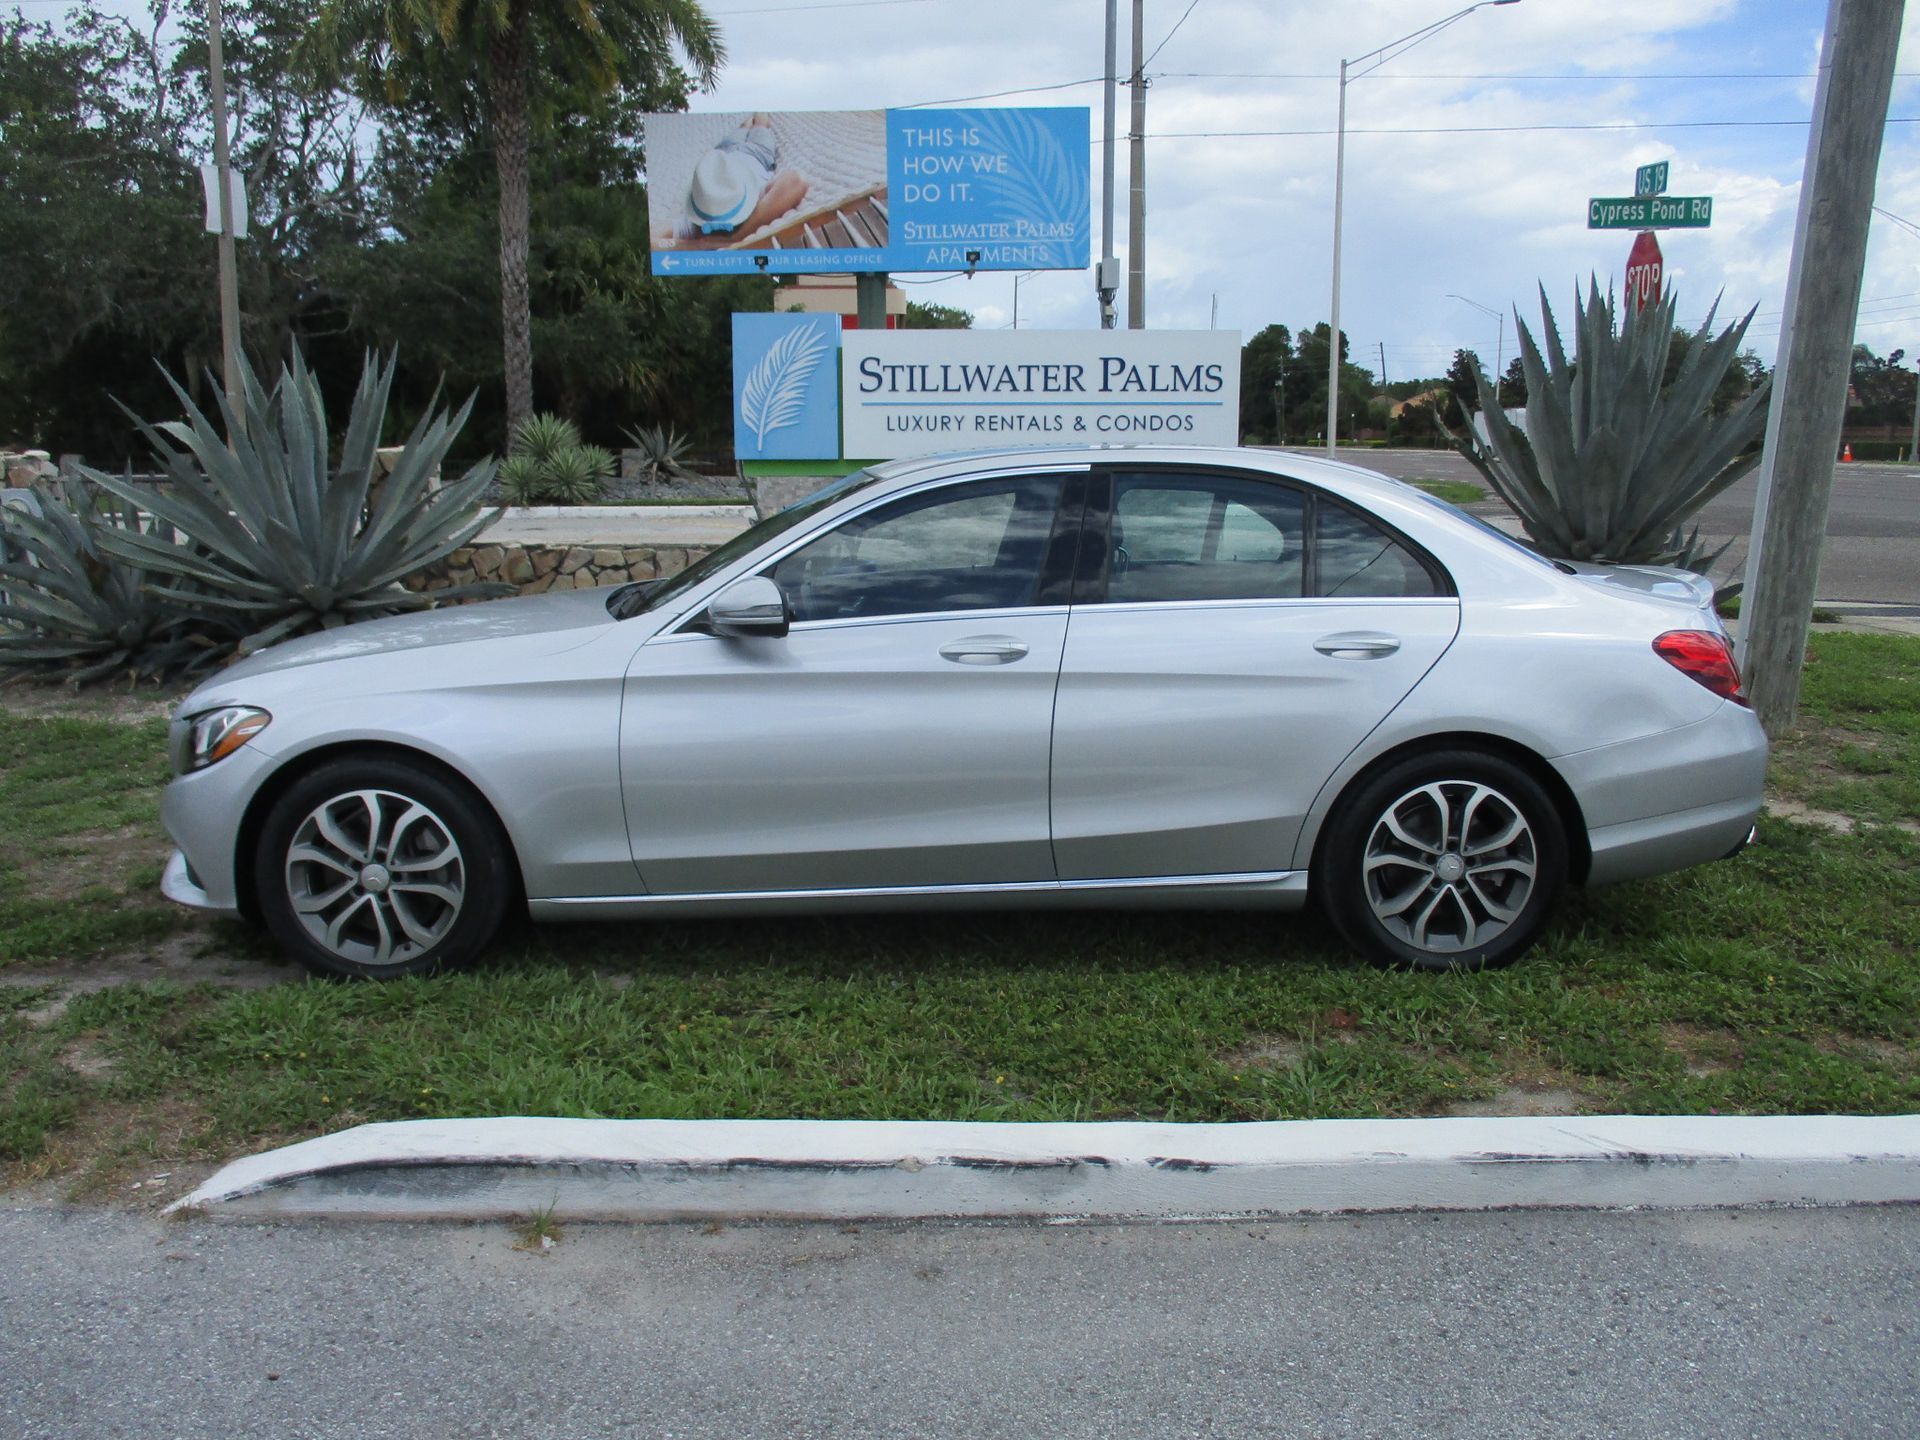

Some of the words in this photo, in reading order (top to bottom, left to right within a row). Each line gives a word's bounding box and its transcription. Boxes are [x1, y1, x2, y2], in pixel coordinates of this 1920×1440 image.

[902, 128, 953, 147] THIS
[963, 128, 980, 146] IS
[904, 156, 964, 175] HOW
[970, 155, 1008, 174] WE
[1638, 168, 1651, 194] US
[1655, 165, 1666, 191] 19
[904, 184, 941, 202] DO
[951, 183, 974, 202] IT.
[1590, 201, 1645, 226] Cypress
[1651, 200, 1685, 219] Pond
[1691, 200, 1709, 219] Rd
[904, 221, 1014, 240] STILLWATER
[1016, 219, 1074, 237] PALMS
[684, 258, 715, 268] TURN
[719, 257, 744, 267] LEFT
[794, 255, 840, 265] LEASING
[844, 254, 882, 265] OFFICE
[859, 356, 1086, 393] STILLWATER
[1098, 356, 1224, 393] PALMS
[886, 415, 965, 432] LUXURY
[975, 415, 1063, 432] RENTALS
[1073, 415, 1087, 431] &
[1096, 414, 1194, 432] CONDOS
